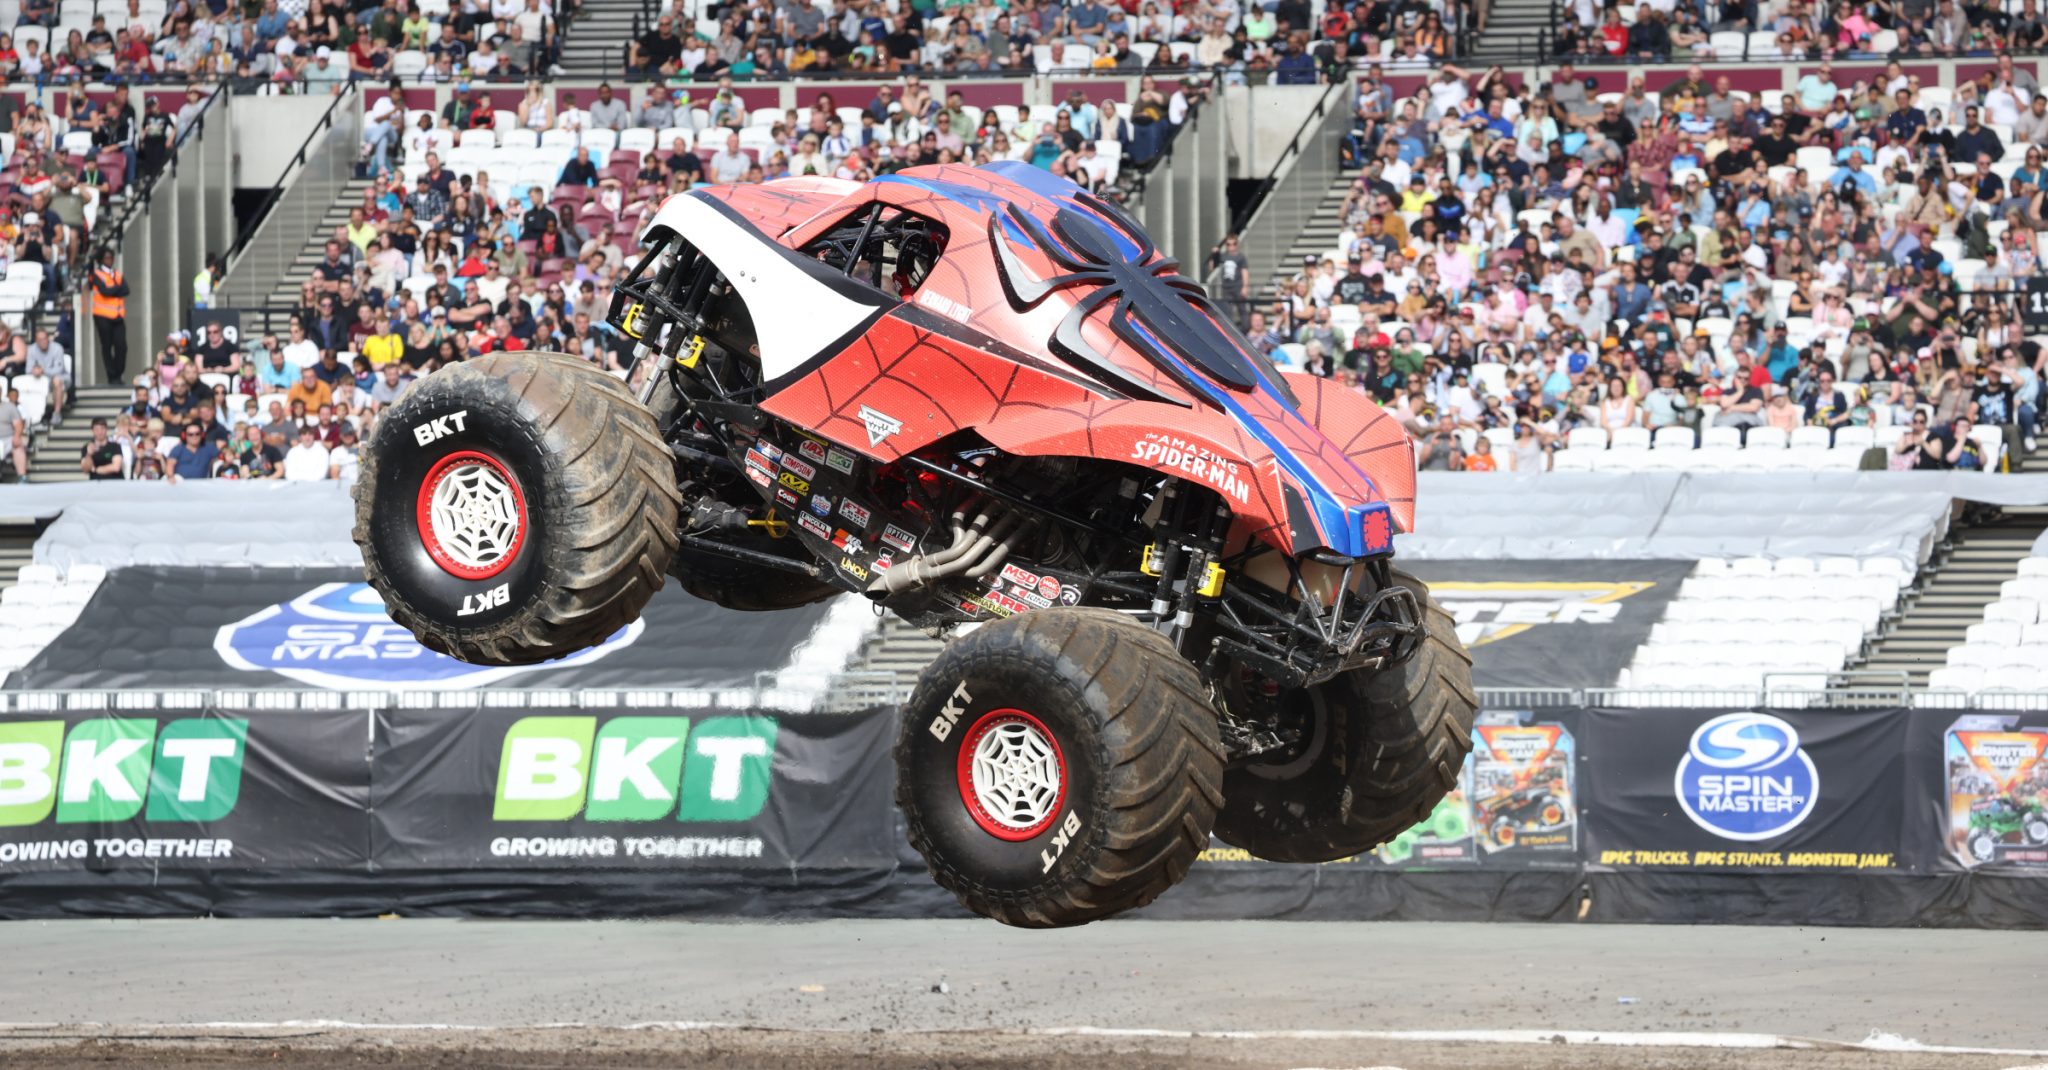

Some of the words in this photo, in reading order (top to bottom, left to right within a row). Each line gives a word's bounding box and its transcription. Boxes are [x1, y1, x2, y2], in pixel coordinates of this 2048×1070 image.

[196, 326, 238, 347] 19
[413, 410, 468, 448] BKT
[1158, 435, 1238, 474] AMAZING
[783, 456, 812, 478] SIMPSON
[801, 511, 828, 531] LINCOLN
[887, 526, 914, 543] OPTIMA
[841, 556, 868, 581] UNOH
[1004, 564, 1037, 585] MSD
[457, 582, 511, 616] BKT
[929, 680, 973, 743] BKT
[0, 738, 236, 807] BKT
[503, 736, 767, 801] BKT
[1698, 775, 1793, 796] SPIN
[0, 840, 88, 862] OWING
[94, 838, 233, 858] TOGETHER
[490, 837, 617, 858] GROWING
[623, 837, 763, 858] TOGETHER
[1038, 809, 1082, 875] BKT
[1600, 850, 1632, 865] EPIC
[1635, 850, 1690, 866] TRUCKS.
[1694, 851, 1726, 866] EPIC
[1727, 851, 1784, 867] STUNTS.
[1787, 852, 1857, 867] MONSTER
